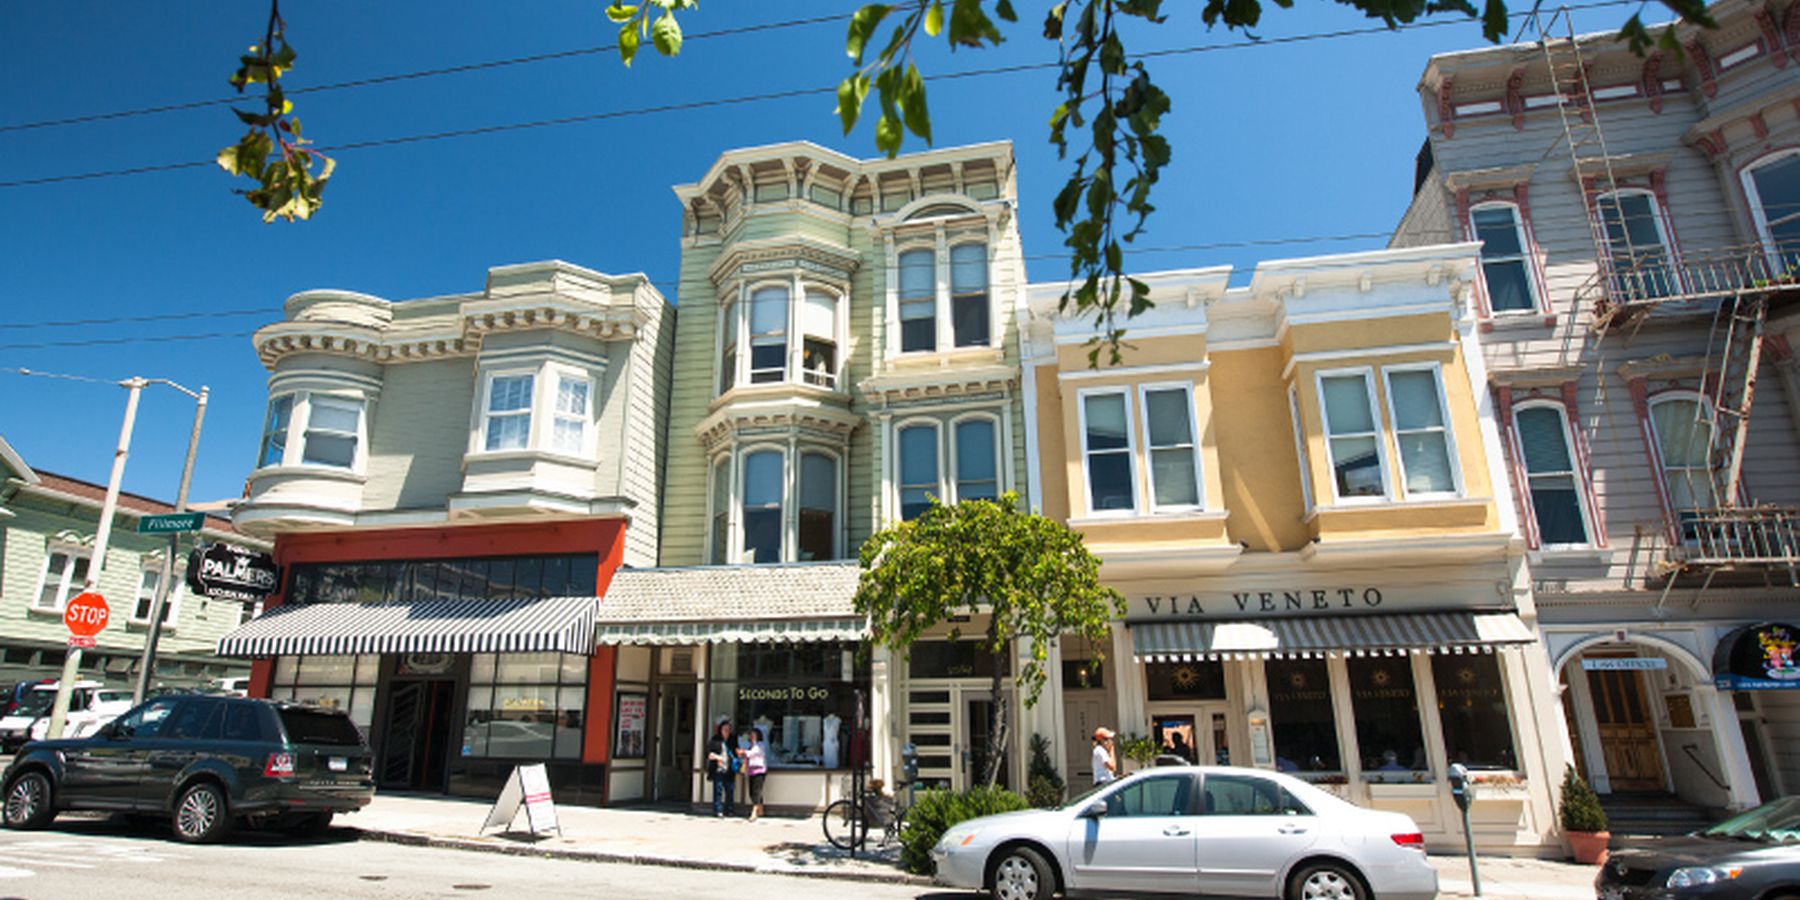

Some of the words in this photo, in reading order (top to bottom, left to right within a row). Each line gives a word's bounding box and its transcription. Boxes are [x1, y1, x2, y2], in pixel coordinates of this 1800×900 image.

[148, 518, 194, 530] Fillmore
[1146, 596, 1204, 614] VIA
[1232, 588, 1383, 612] VENETO
[67, 603, 107, 625] STOP
[739, 687, 788, 700] SECONDS
